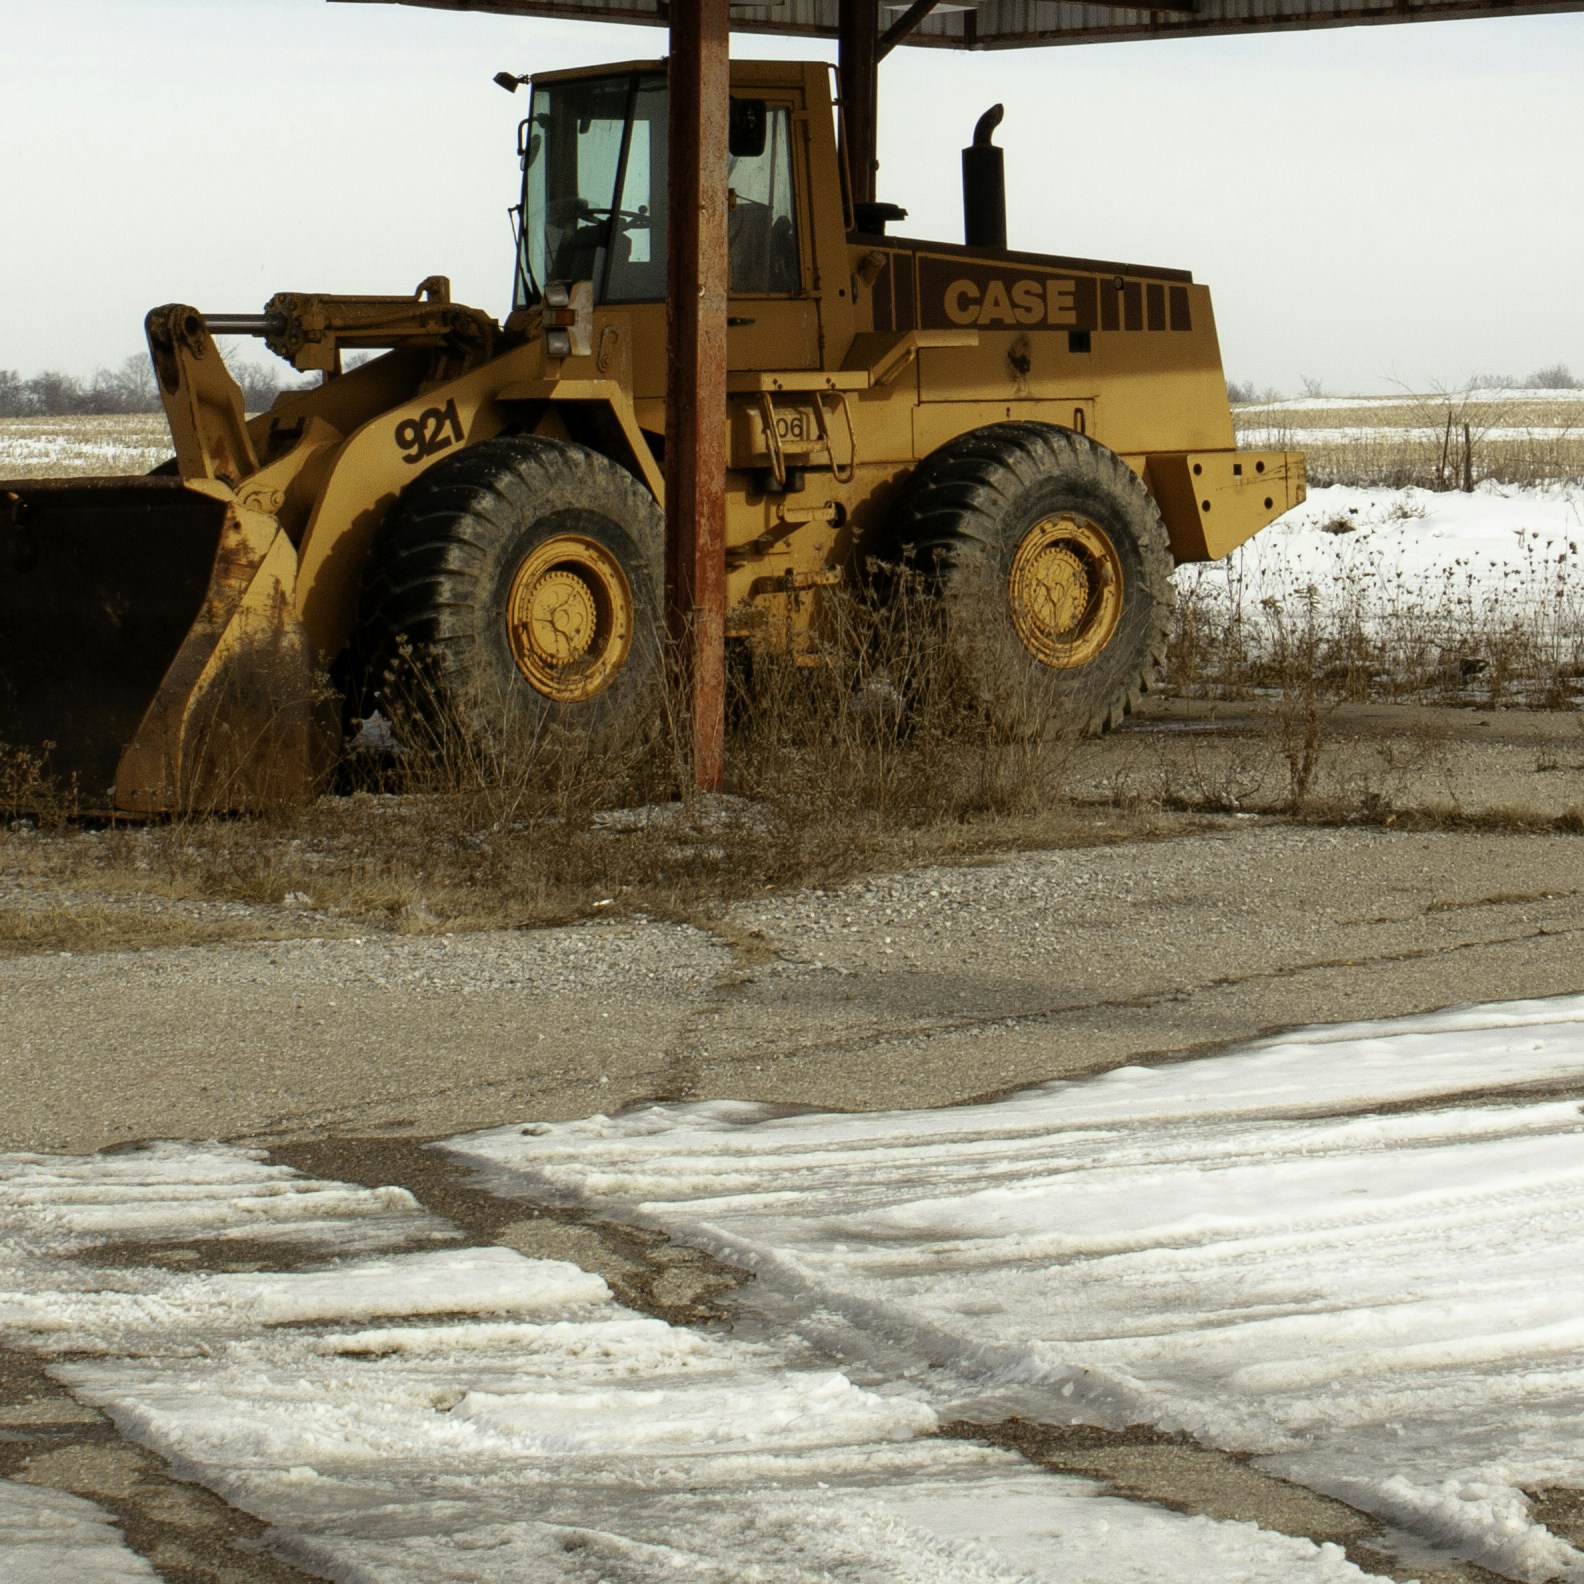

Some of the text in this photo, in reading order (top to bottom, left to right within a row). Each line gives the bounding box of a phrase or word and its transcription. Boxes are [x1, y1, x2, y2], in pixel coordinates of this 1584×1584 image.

[943, 279, 1077, 325] CASE
[394, 397, 465, 464] 921
[761, 417, 803, 439] 06
